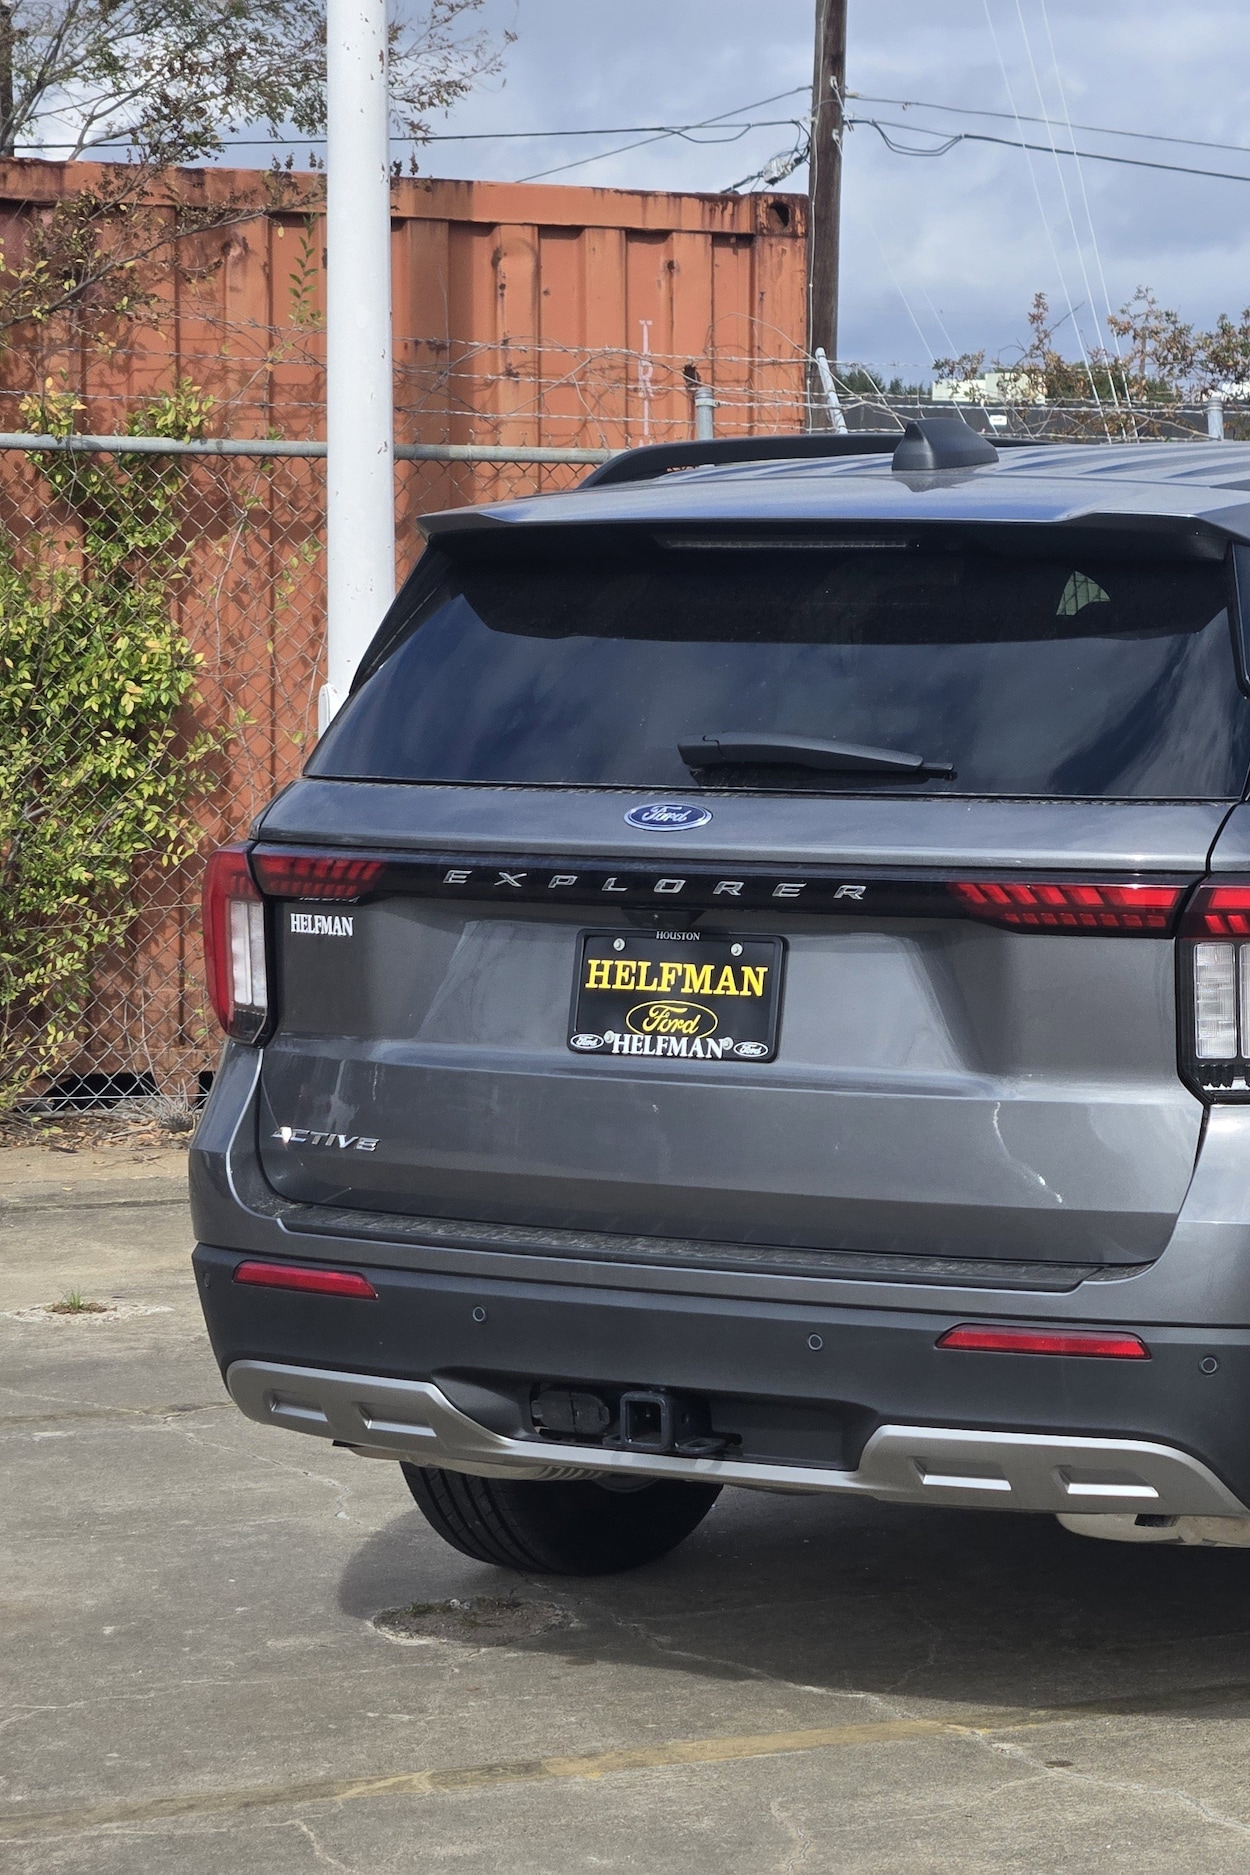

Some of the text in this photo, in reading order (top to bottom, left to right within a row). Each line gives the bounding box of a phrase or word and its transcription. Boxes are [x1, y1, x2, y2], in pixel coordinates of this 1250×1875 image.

[642, 805, 692, 822] Ford
[443, 869, 867, 900] EXPLORER
[290, 913, 354, 937] HELFMAN
[656, 930, 701, 941] HOUSTON
[585, 959, 769, 997] HELFMAN
[642, 1004, 702, 1035] Ford
[575, 1033, 763, 1059] Ford HELFMAN Ford
